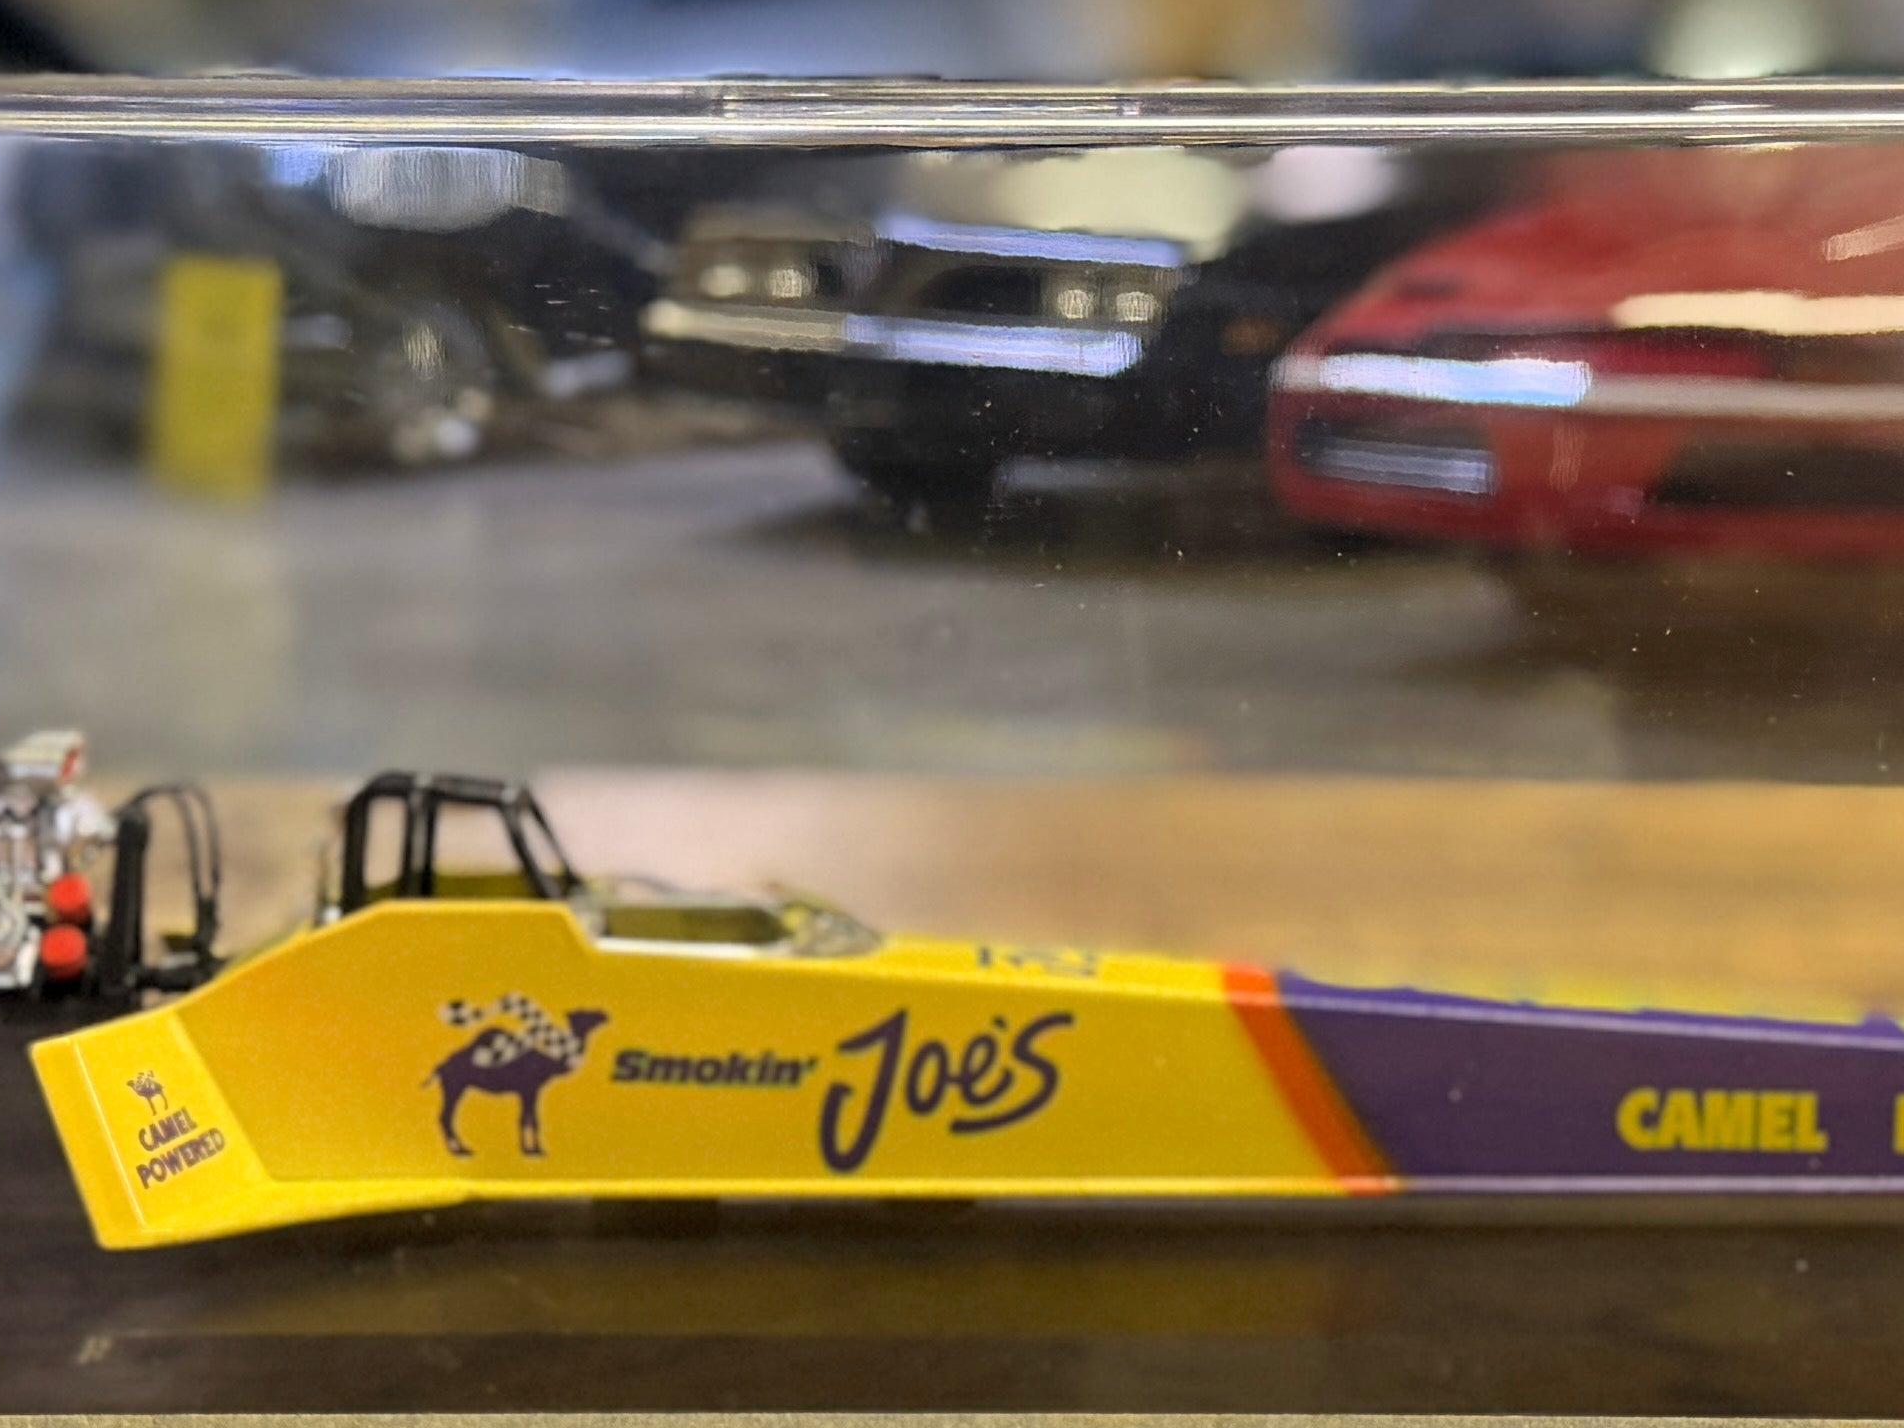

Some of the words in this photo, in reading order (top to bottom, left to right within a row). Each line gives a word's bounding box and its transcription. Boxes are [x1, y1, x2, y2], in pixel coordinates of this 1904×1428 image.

[610, 1049, 818, 1089] Smokin'
[138, 1106, 198, 1152] CAMEL
[1615, 1087, 1829, 1153] CAMEL
[136, 1128, 225, 1190] POWERED
